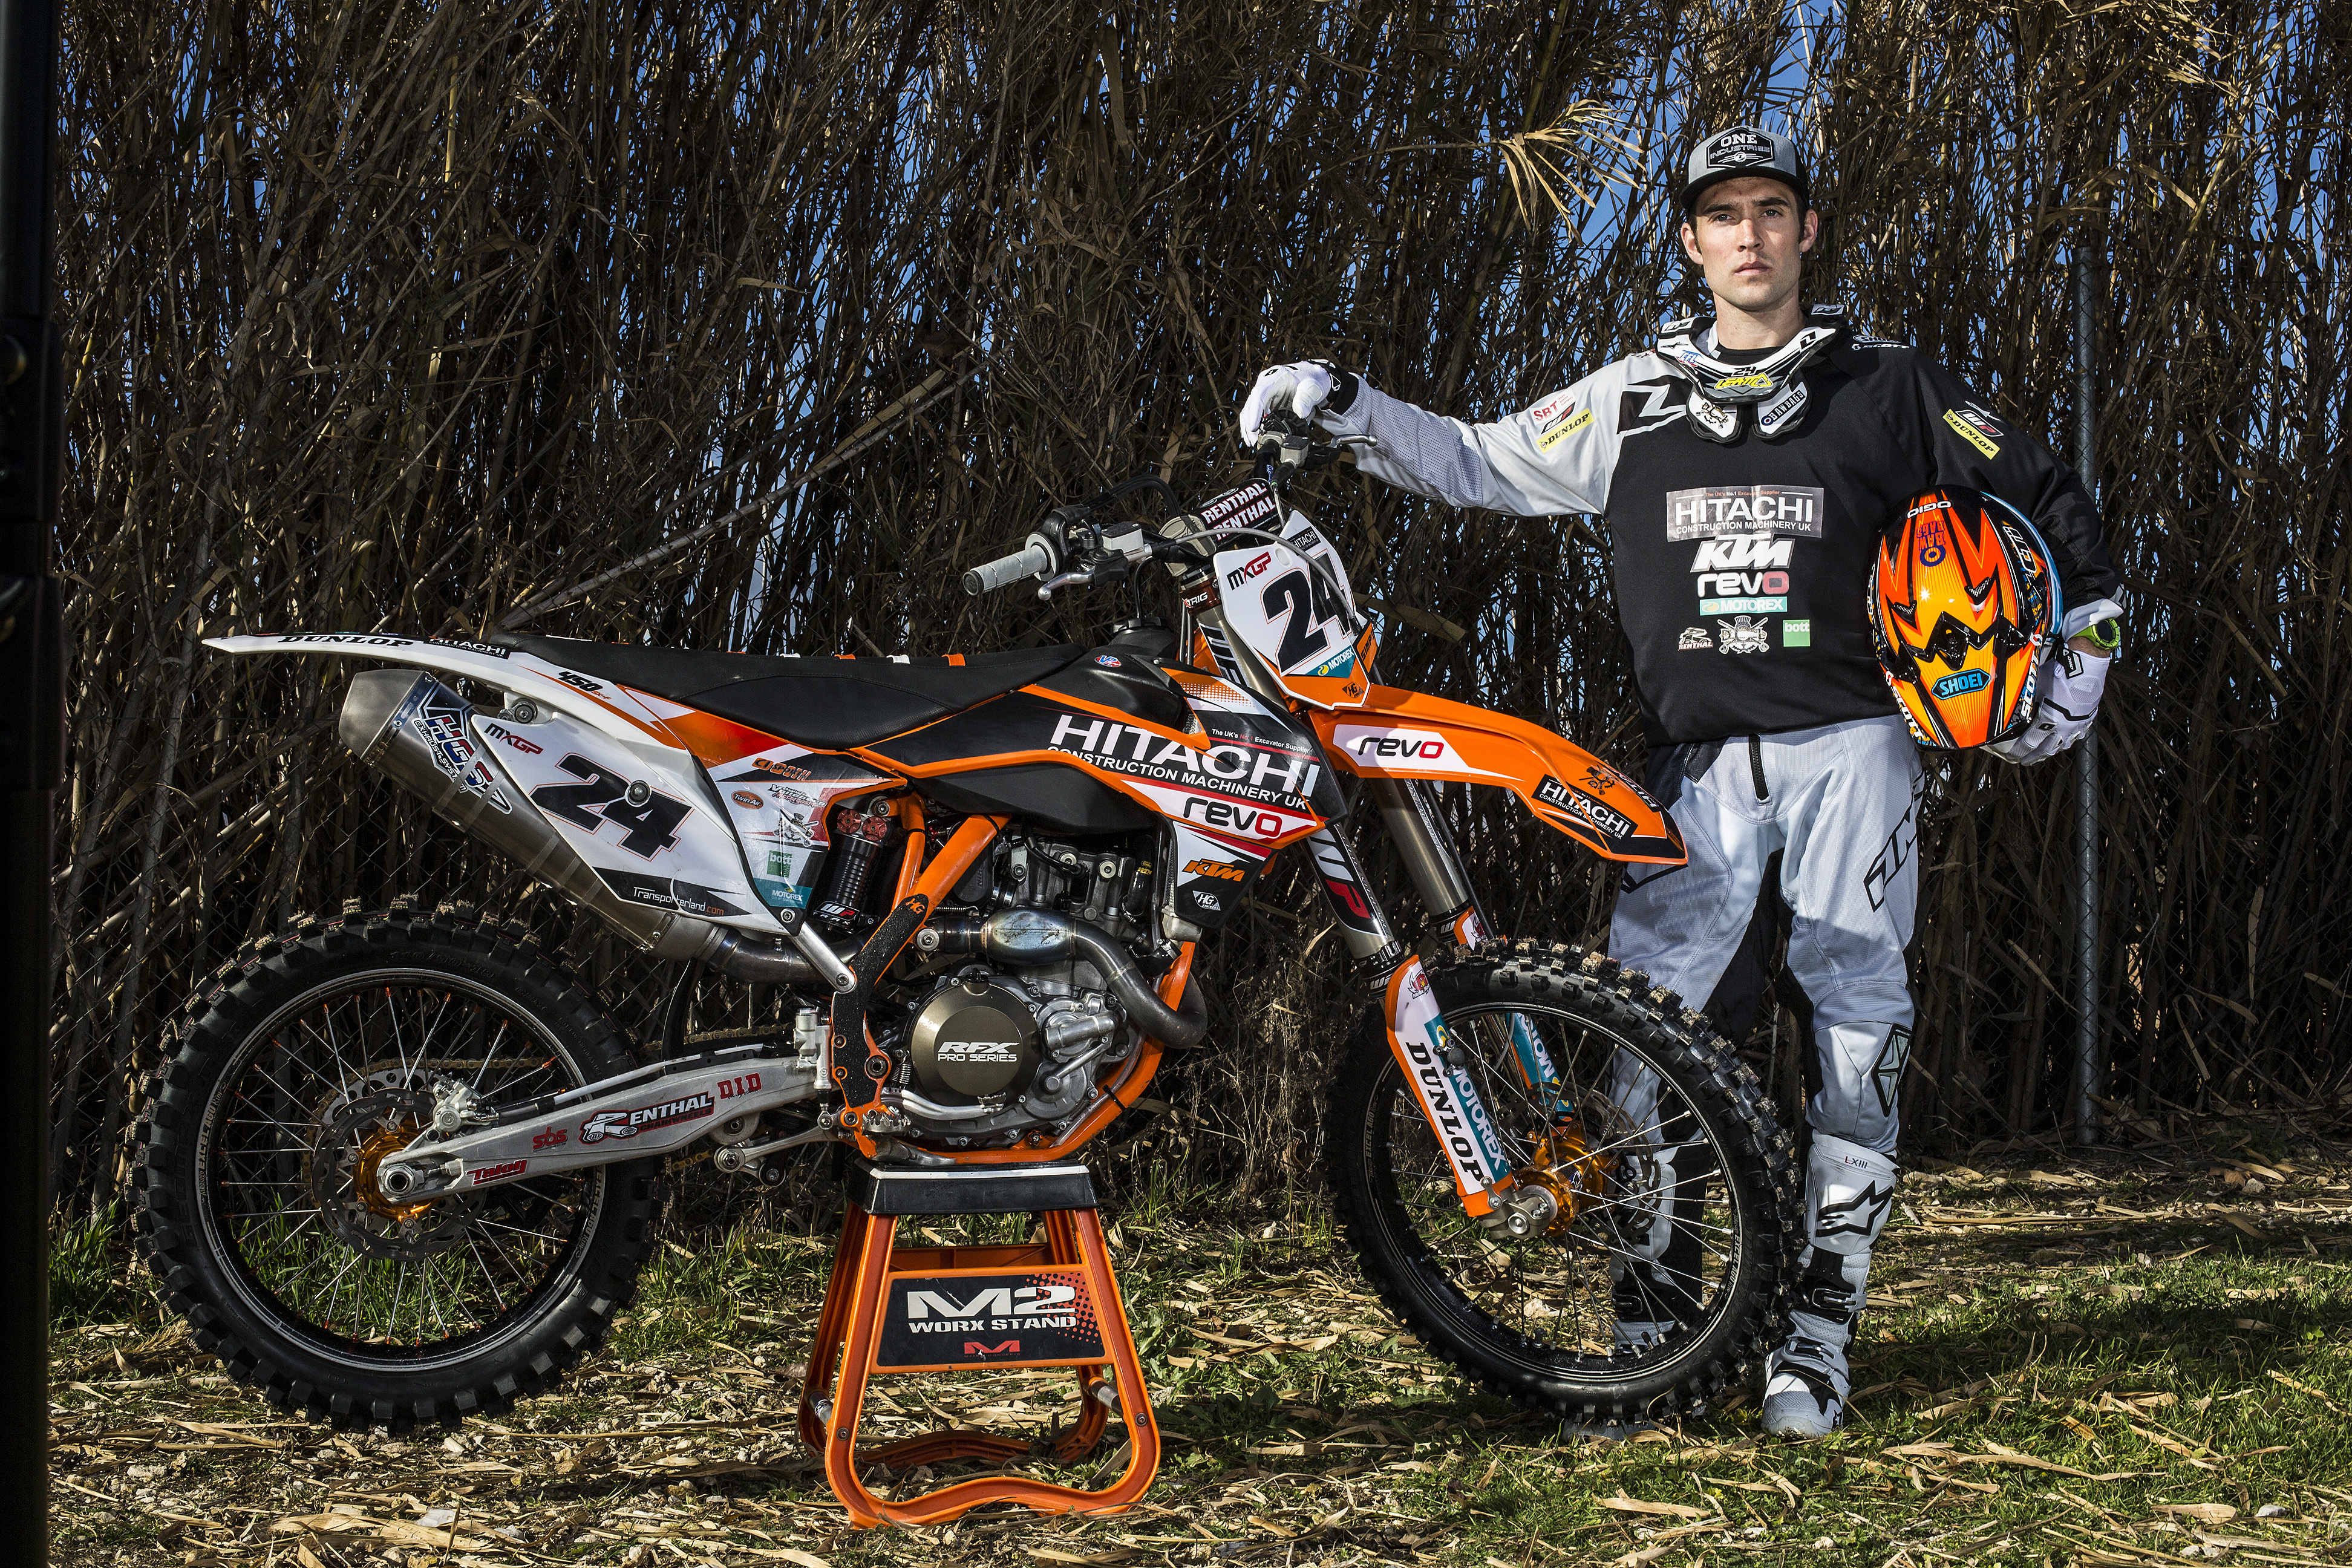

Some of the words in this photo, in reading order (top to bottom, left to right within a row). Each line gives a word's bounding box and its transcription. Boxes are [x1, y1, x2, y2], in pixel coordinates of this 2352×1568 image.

[1710, 145, 1770, 159] INDUSTRIES
[1721, 134, 1757, 147] ONE
[1731, 367, 1756, 376] 24
[1534, 400, 1557, 421] SBT
[1771, 390, 1805, 422] BAWBAGS
[1548, 413, 1590, 444] DUNLOP
[1952, 420, 1994, 452] DUNLOP
[1201, 483, 1267, 524] RENTHAL
[1676, 496, 1813, 525] HITACHI
[1676, 521, 1742, 535] CONSTRUCTION
[1745, 520, 1797, 531] MACHINERY
[1798, 523, 1811, 532] UK
[1694, 533, 1792, 569] KTM
[1227, 551, 1272, 590] MXGP
[1697, 571, 1789, 598] revo
[1262, 552, 1352, 674] 24
[1720, 598, 1783, 612] MOTOREX
[1785, 622, 1810, 632] bott
[277, 635, 413, 647] DUNLOP
[1678, 641, 1714, 650] RENTHAL
[1327, 647, 1354, 670] MOTOREX
[558, 671, 603, 692] 450
[1939, 673, 1983, 695] SHOEI
[2020, 650, 2039, 720] SCOTT
[1891, 686, 1924, 739] SCOTT
[425, 716, 494, 786] HGS
[484, 722, 543, 756] MXGP
[1224, 730, 1238, 739] UK's
[1255, 736, 1285, 748] Excavator
[1285, 743, 1310, 754] Supplier
[1358, 736, 1444, 759] revo
[414, 719, 442, 757] EXHAUST
[440, 757, 468, 791] SYSTM
[1050, 714, 1321, 797] HITACHI
[734, 793, 750, 803] Twin
[750, 798, 762, 807] Air
[1182, 773, 1282, 803] MACHINERY
[1284, 797, 1309, 811] UK
[530, 754, 695, 859] 24
[1183, 797, 1282, 838] revo
[1540, 793, 1584, 816] CONSTRUCTION
[1583, 814, 1615, 834] MACHINERY
[1542, 781, 1630, 836] HITACHI
[1183, 859, 1245, 881] KTM
[772, 890, 803, 901] MOTOREX
[906, 898, 925, 915] HG
[1198, 893, 1214, 905] HG
[821, 903, 855, 916] WP
[938, 1042, 1020, 1053] RFX
[938, 1053, 965, 1062] PRO
[969, 1053, 1017, 1062] SERIES
[720, 1072, 762, 1100] DID
[638, 1106, 713, 1133] CHAINWHEELS
[1406, 1041, 1488, 1184] DUNLOP
[1453, 1066, 1508, 1171] MOTOREX
[195, 1129, 209, 1169] EXCEL
[202, 1105, 216, 1128] A60
[532, 1126, 568, 1149] sbs
[466, 1158, 528, 1183] Talon
[1844, 1156, 1868, 1169] LXIII
[907, 1285, 1076, 1319] M2
[909, 1320, 984, 1333] WORX
[991, 1316, 1077, 1331] STAND
